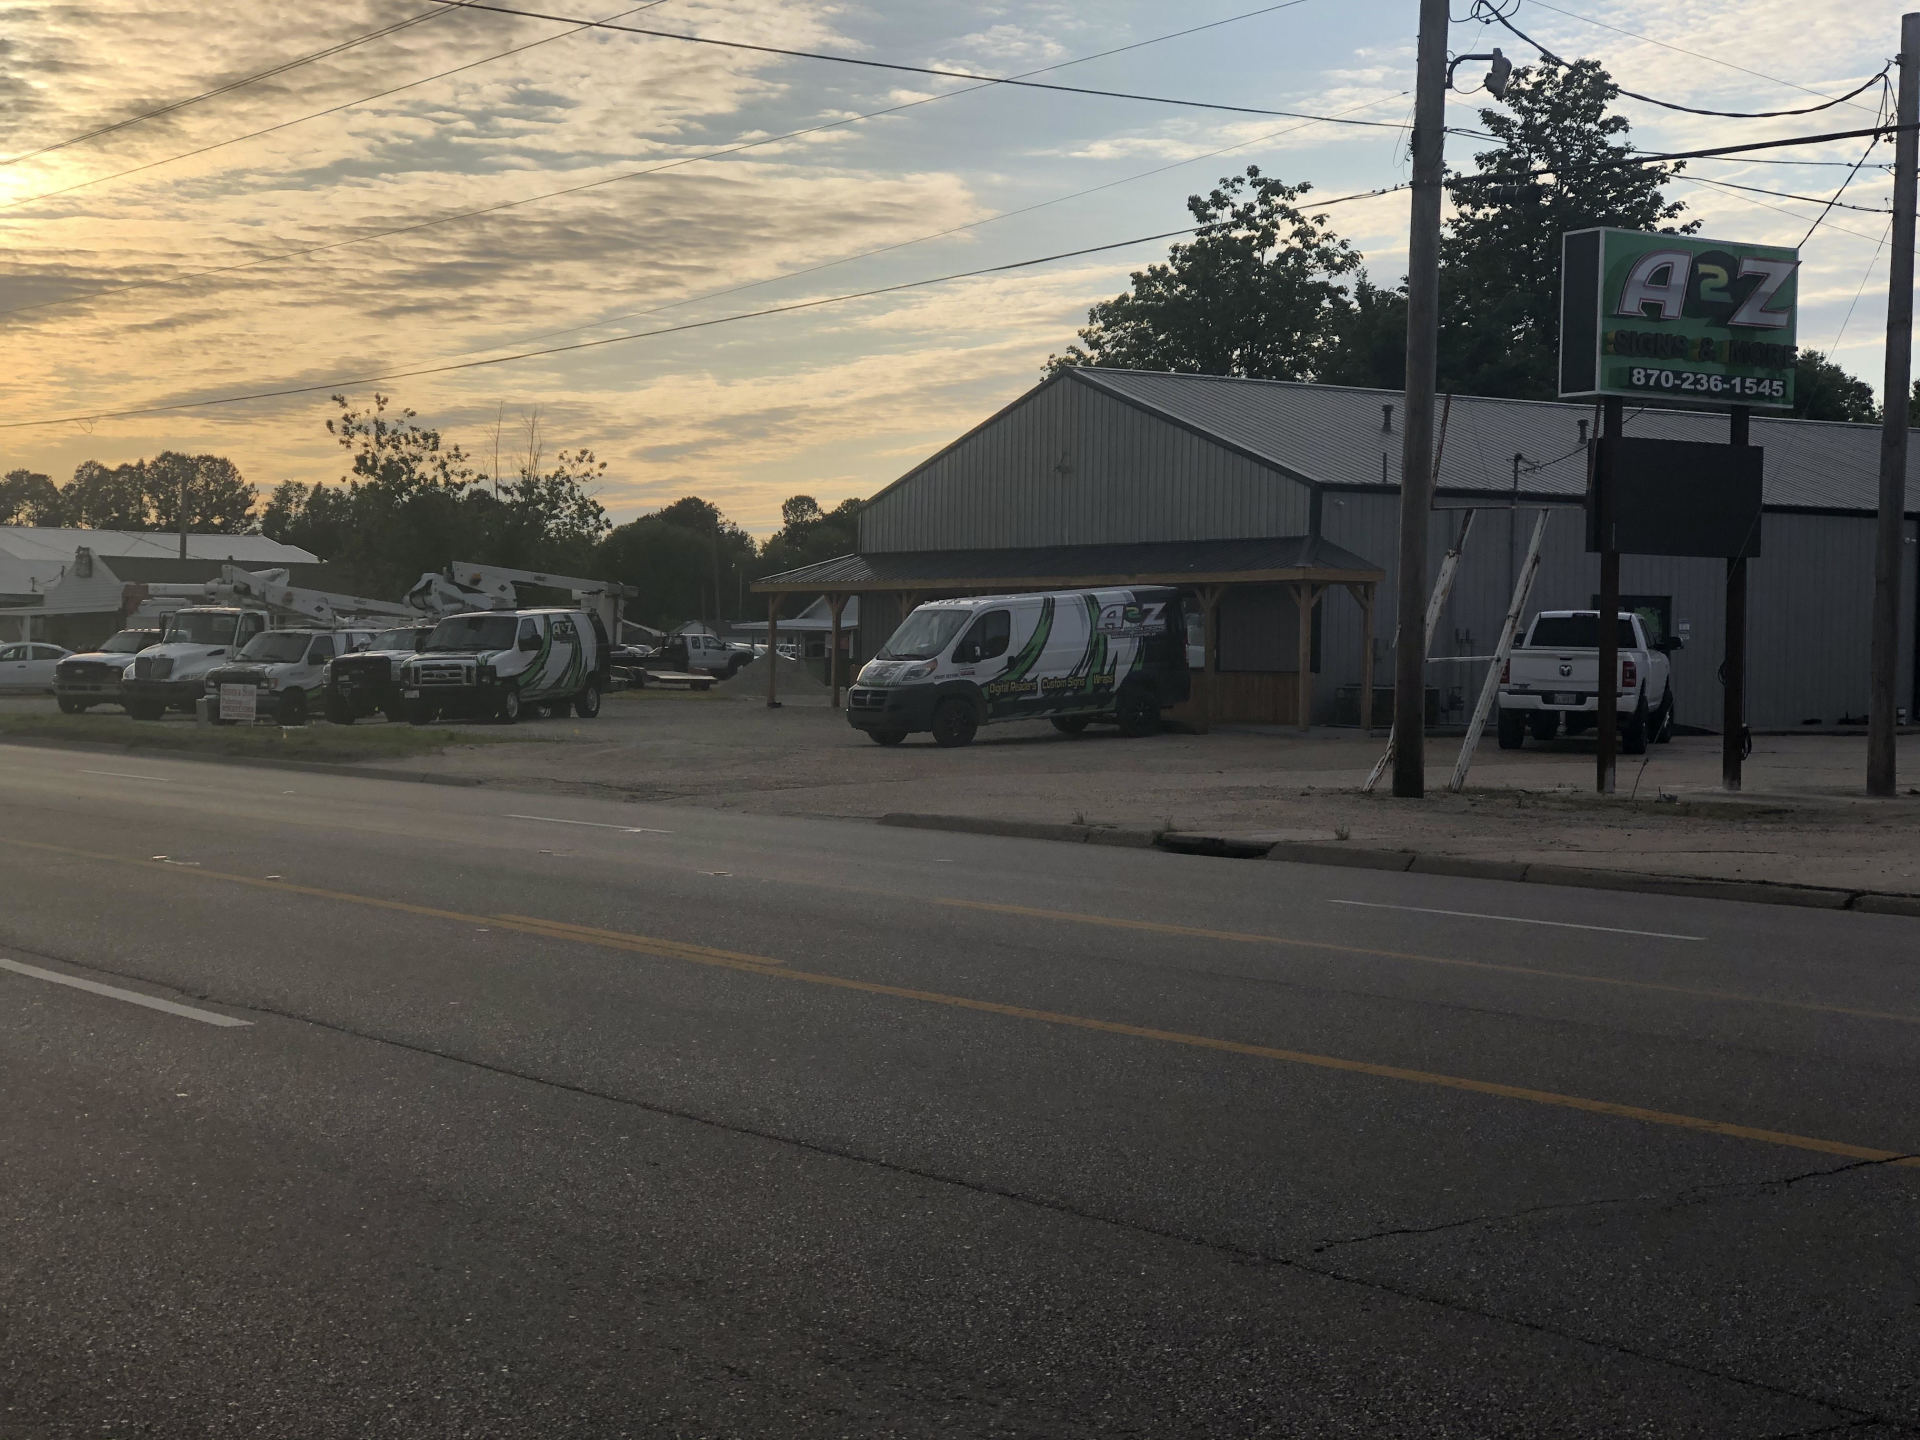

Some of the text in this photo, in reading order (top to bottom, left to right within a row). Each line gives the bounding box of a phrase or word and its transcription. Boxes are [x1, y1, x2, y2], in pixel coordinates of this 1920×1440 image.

[1617, 248, 1802, 329] A2Z
[1614, 330, 1799, 368] SIGNS & MORE
[1632, 368, 1785, 397] 870-236-1545
[1097, 601, 1168, 630] A2Z
[1041, 676, 1086, 690] Custom Signs
